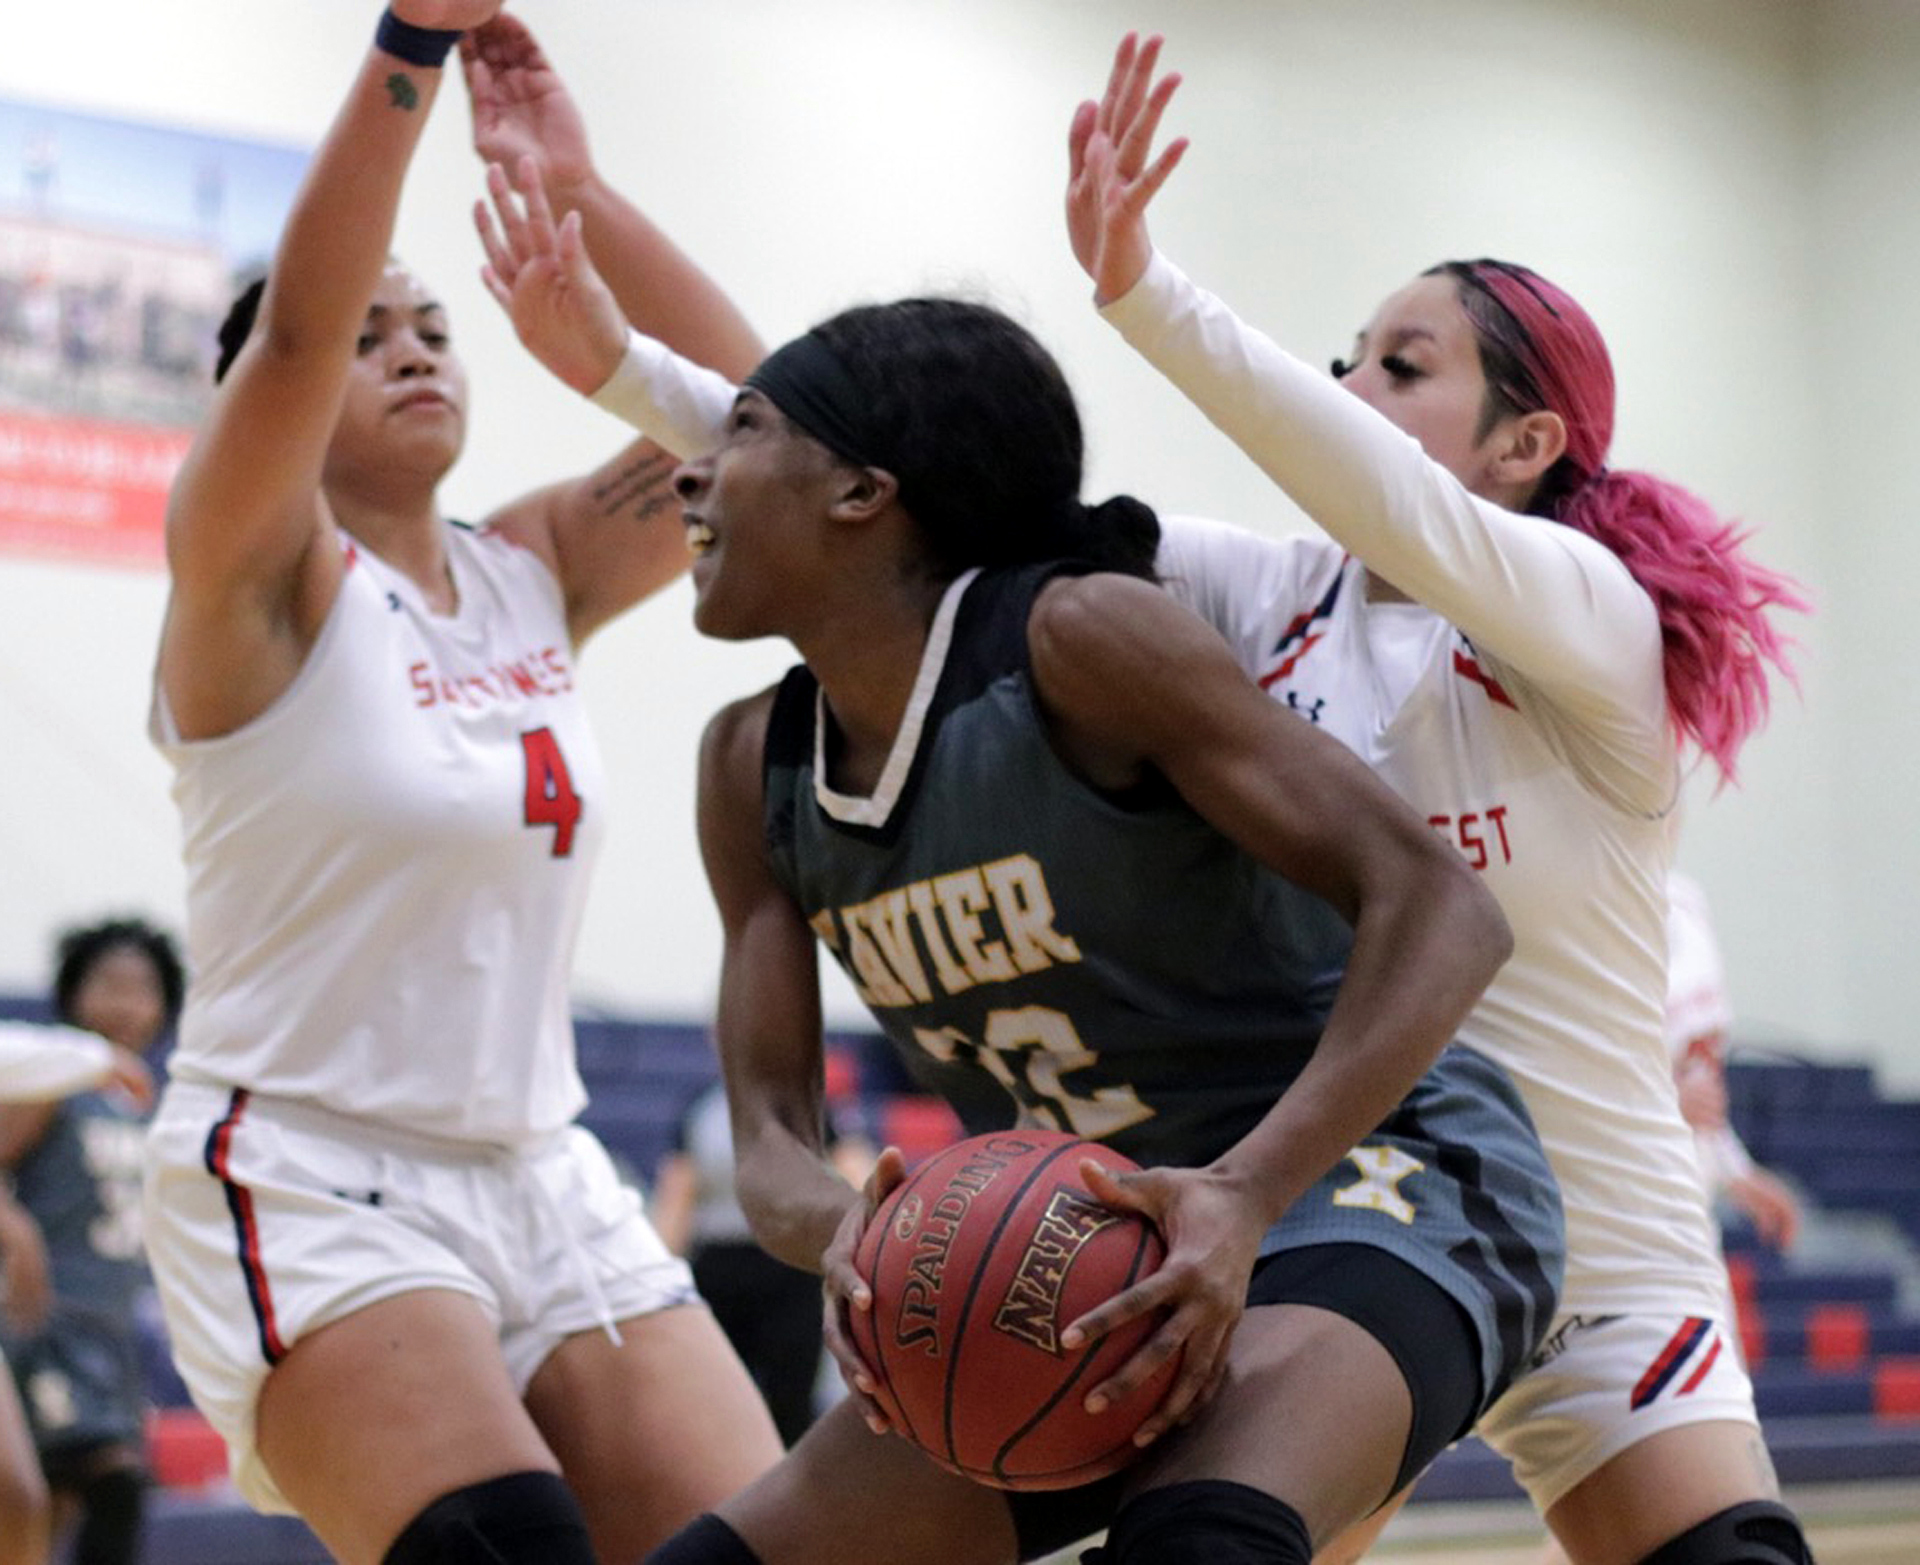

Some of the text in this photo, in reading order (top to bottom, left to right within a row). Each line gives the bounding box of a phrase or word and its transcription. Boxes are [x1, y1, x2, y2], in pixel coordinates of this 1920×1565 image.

[518, 725, 585, 858] 4
[808, 853, 1084, 1008] AVIER
[895, 1137, 1037, 1359] SPALDING
[1332, 1146, 1426, 1226] X
[990, 1182, 1125, 1360] NAIA
